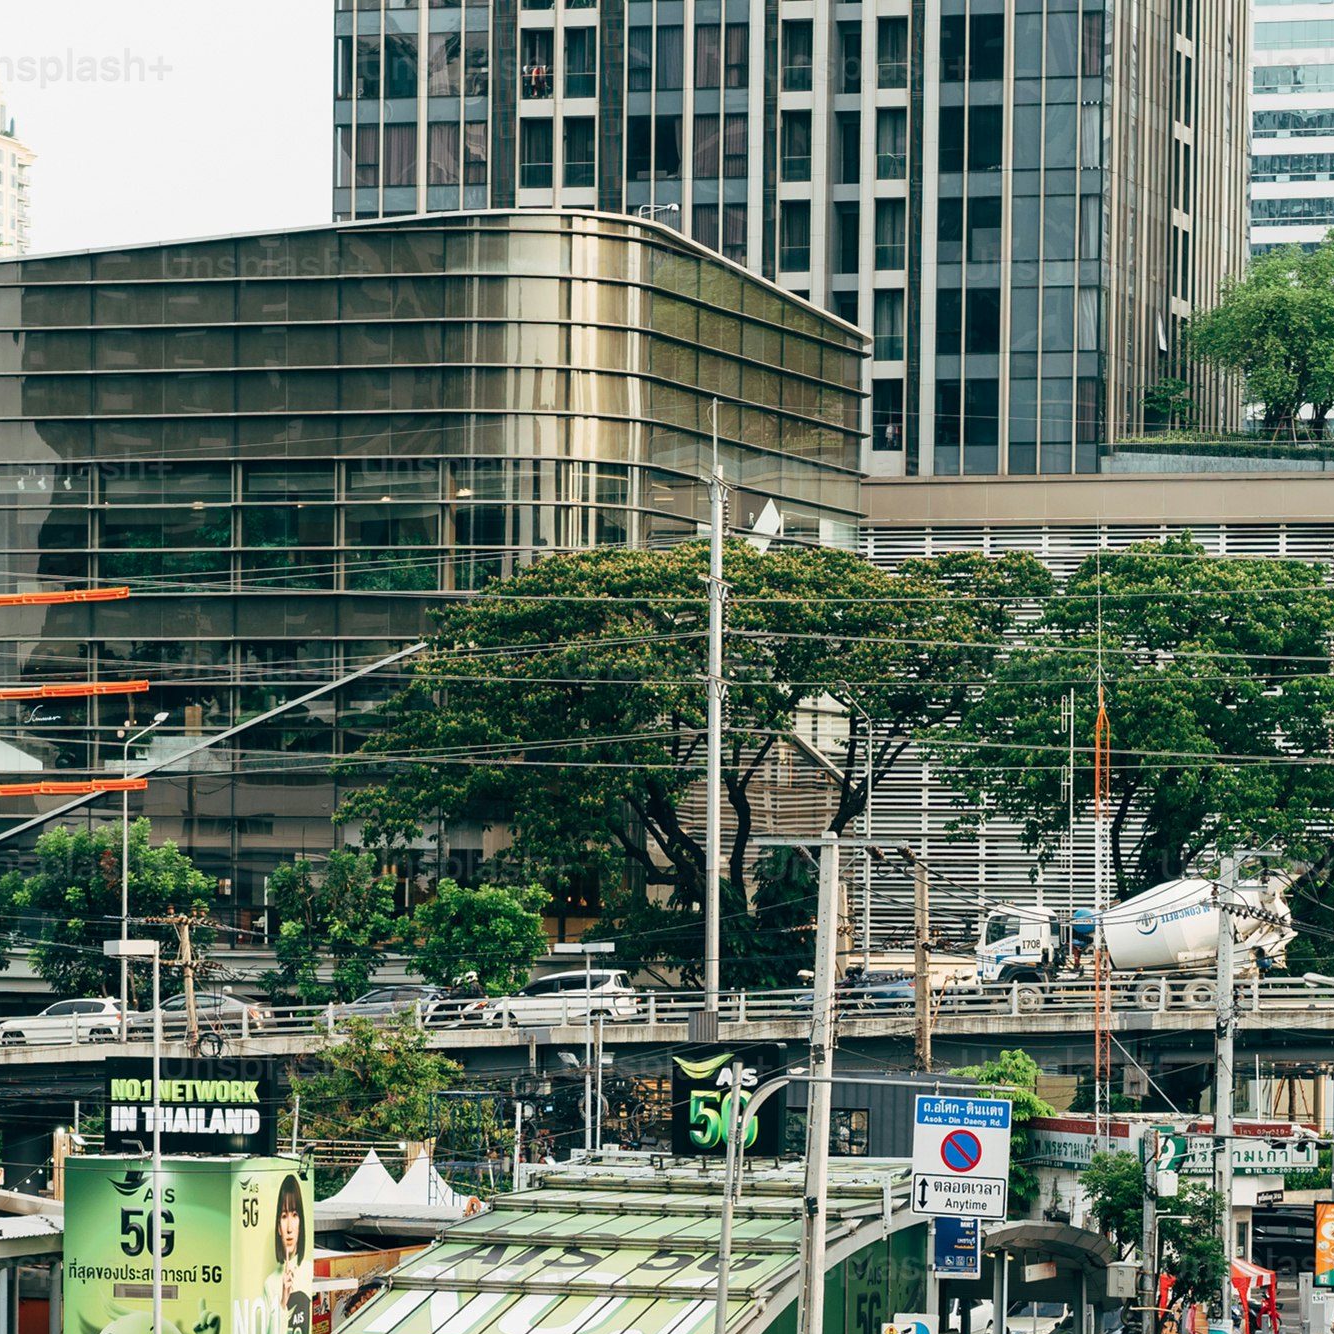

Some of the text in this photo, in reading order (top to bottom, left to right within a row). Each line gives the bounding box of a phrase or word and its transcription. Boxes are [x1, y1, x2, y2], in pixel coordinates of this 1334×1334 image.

[715, 1067, 759, 1087] AS
[110, 1079, 260, 1104] NO.1 NETWORK
[110, 1105, 261, 1136] IN THAILAND
[963, 1118, 988, 1128] Daeng
[247, 1182, 259, 1194] AIS
[933, 1179, 1002, 1198] ตลอดเวลา
[241, 1199, 259, 1229] 5G
[944, 1197, 988, 1212] Anytime
[120, 1206, 176, 1258] 5G
[201, 1265, 227, 1285] 5G
[292, 1312, 305, 1325] AIS
